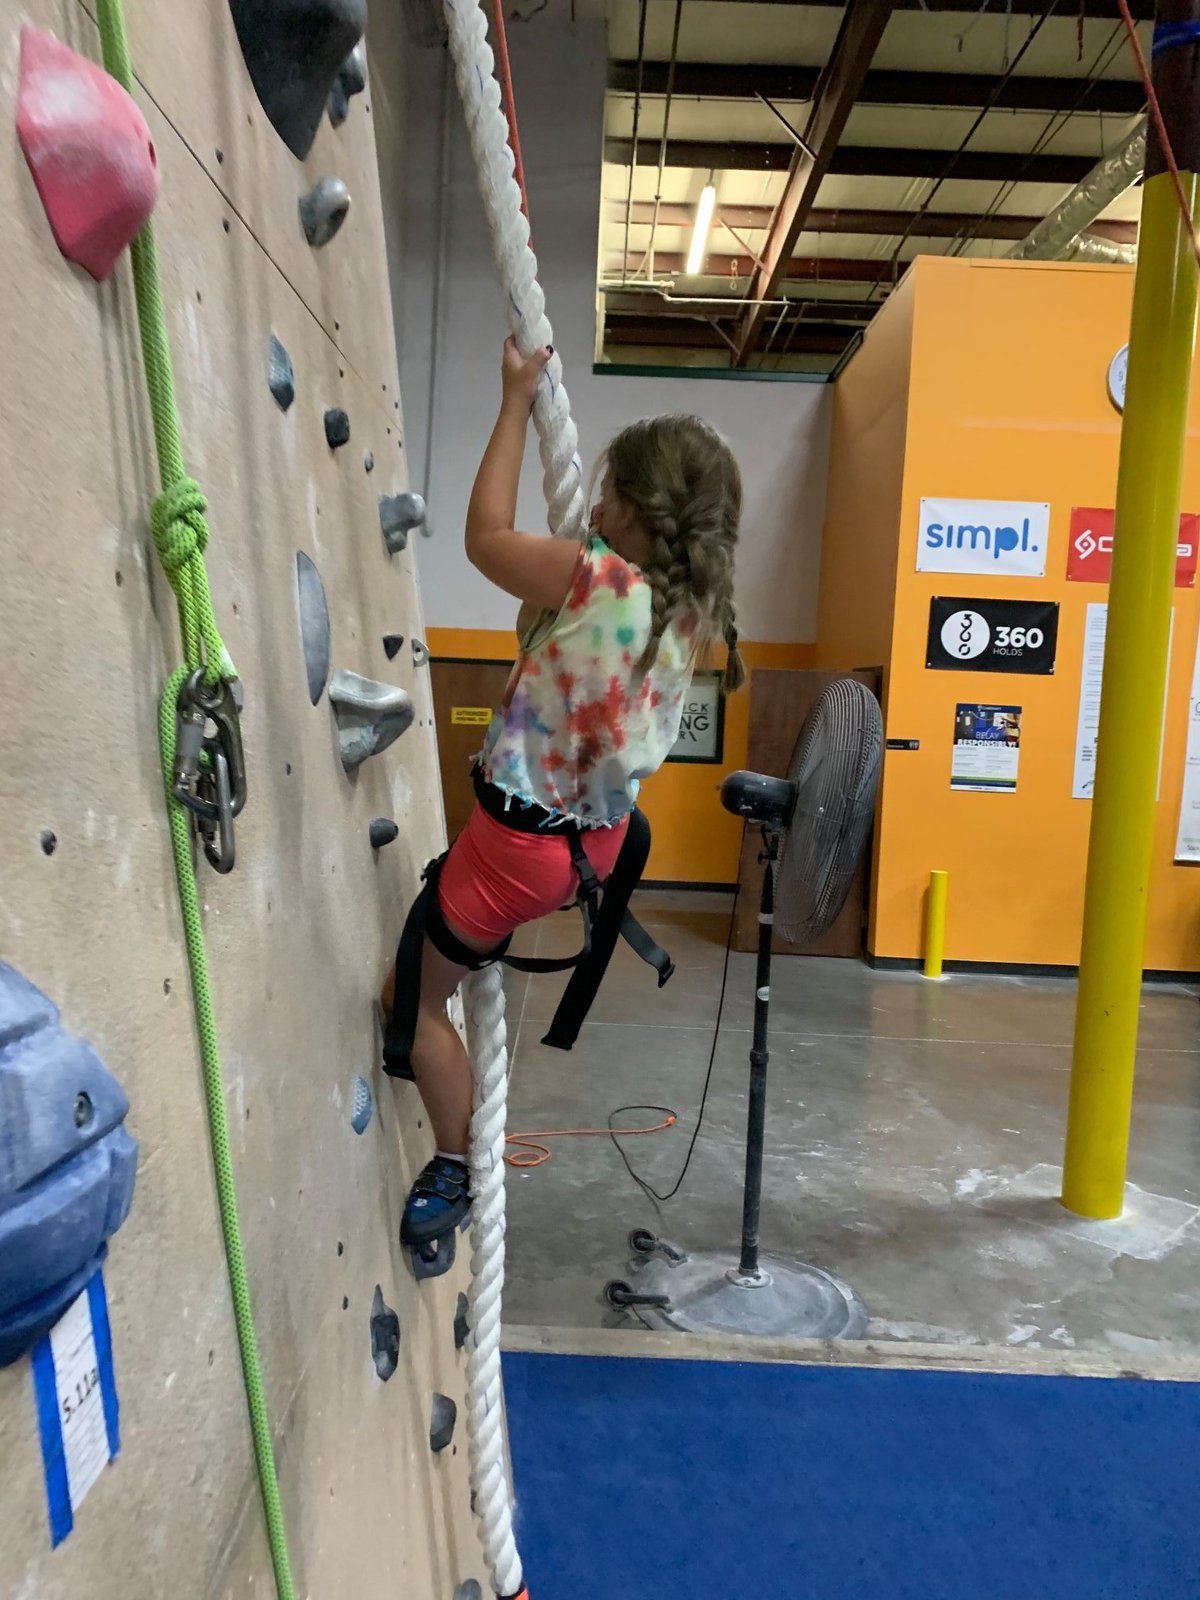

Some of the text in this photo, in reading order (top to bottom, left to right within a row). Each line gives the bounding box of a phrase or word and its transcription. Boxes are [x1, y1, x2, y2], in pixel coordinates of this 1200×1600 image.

[994, 626, 1044, 648] 360
[992, 647, 1023, 656] HOLDS
[975, 731, 1001, 740] BELAY
